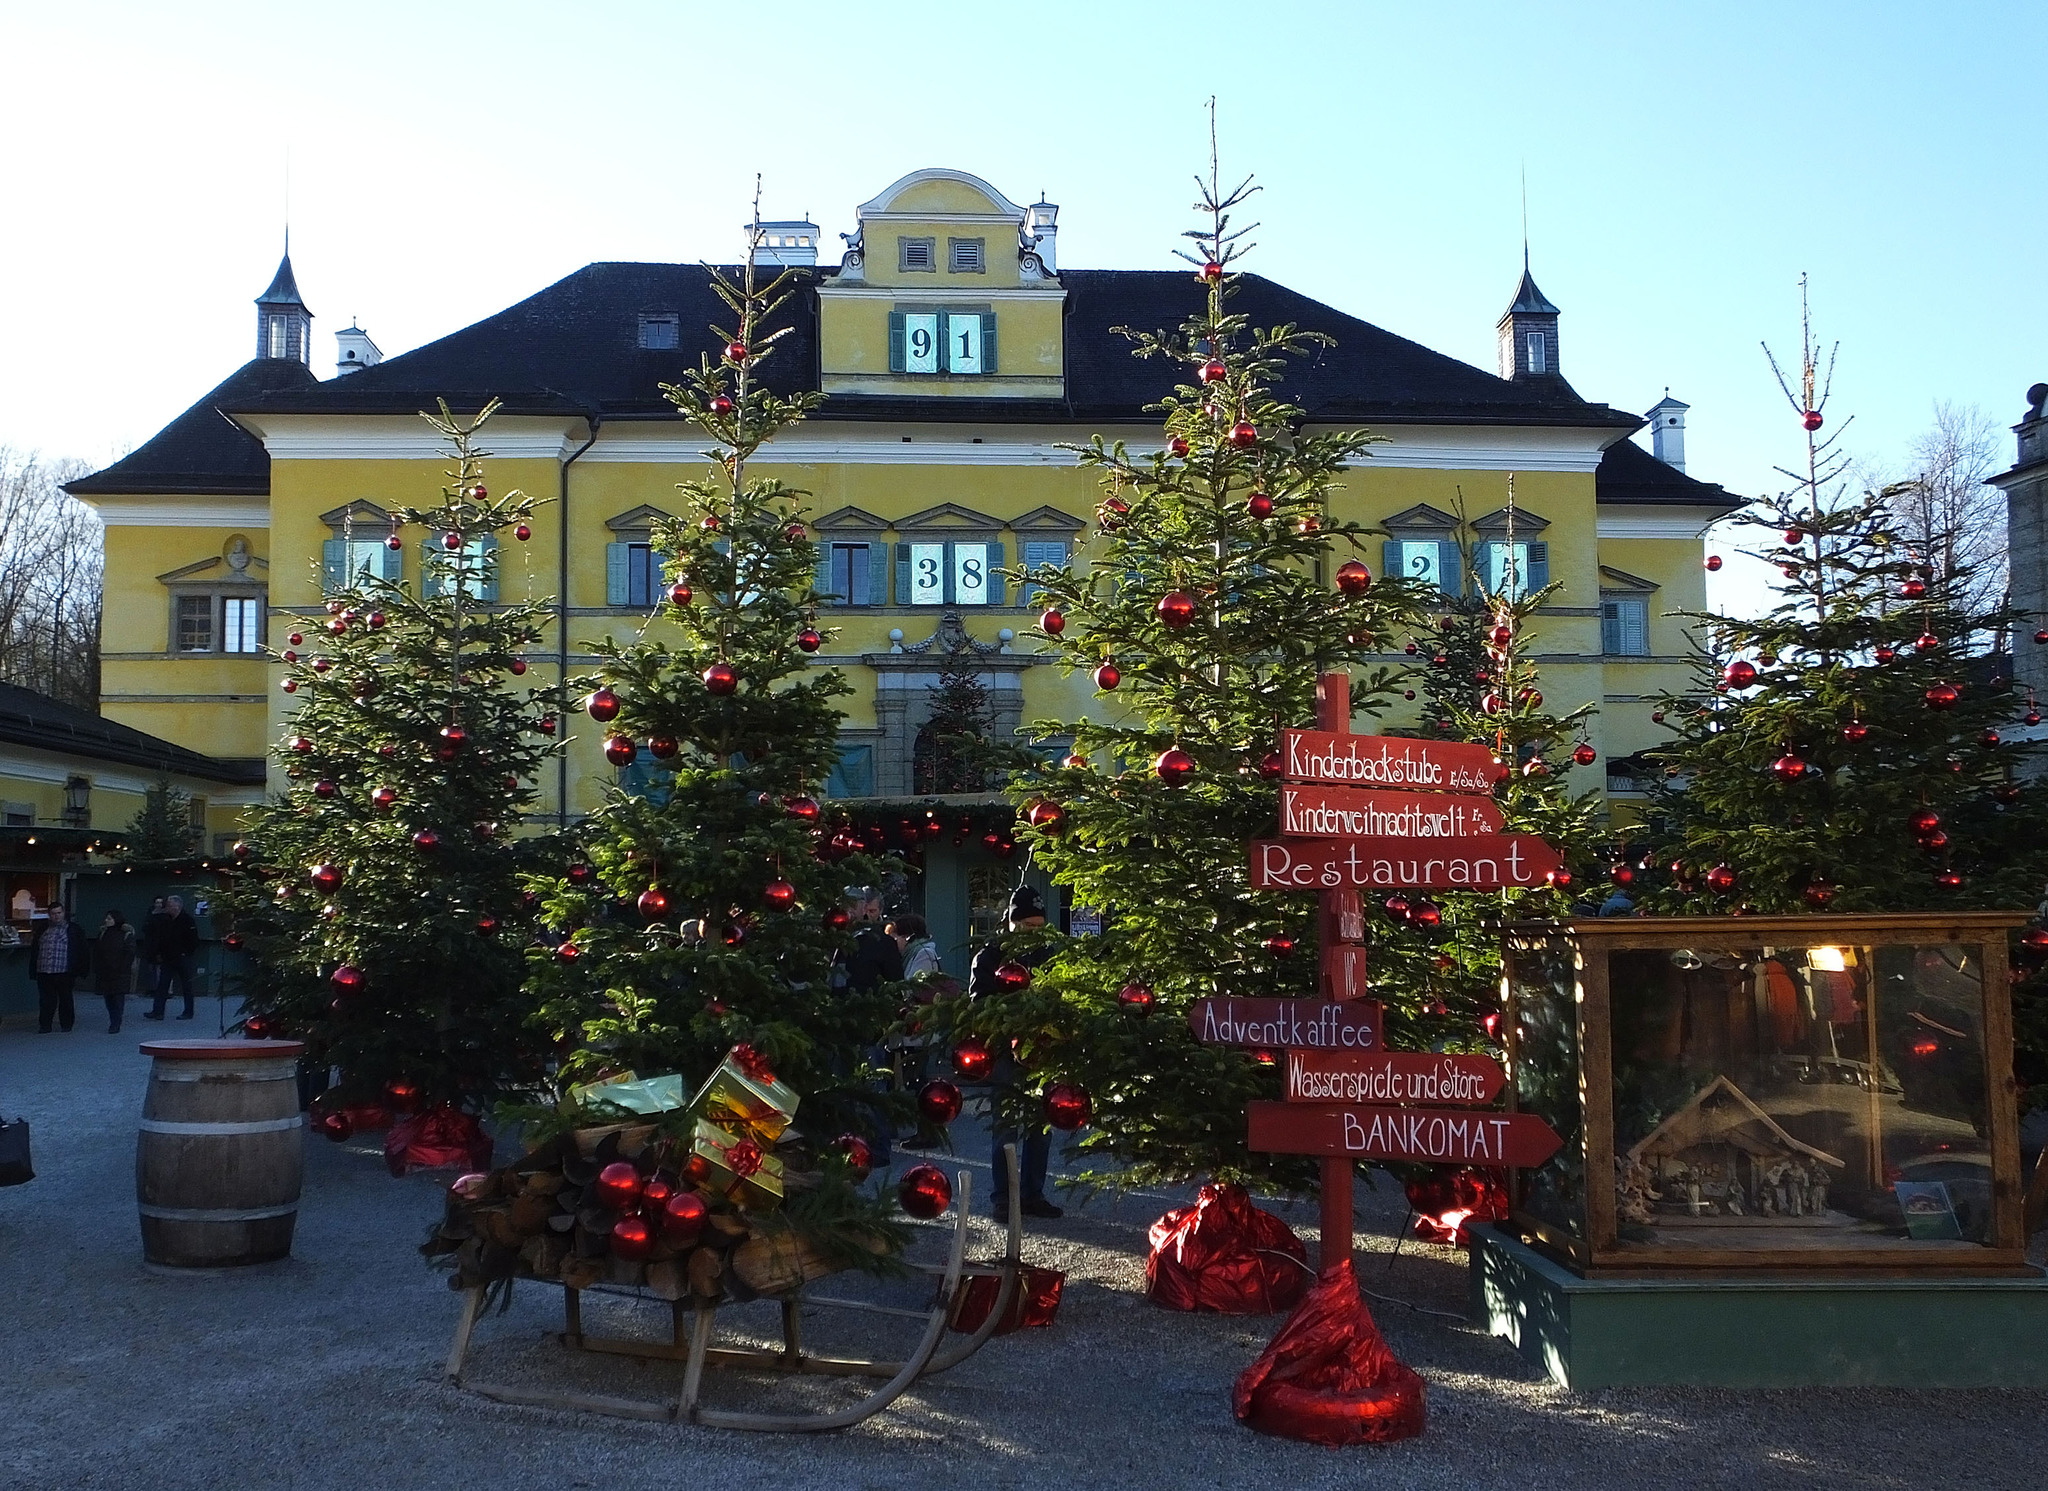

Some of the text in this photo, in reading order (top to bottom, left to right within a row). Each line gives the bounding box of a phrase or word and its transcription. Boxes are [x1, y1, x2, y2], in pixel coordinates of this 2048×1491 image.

[912, 329, 931, 358] 9
[958, 330, 973, 358] 1
[918, 559, 938, 588] 3
[962, 559, 982, 588] 8
[1411, 556, 1431, 583] 2
[1503, 557, 1520, 587] 5
[1288, 734, 1443, 785] Kinderbackstube
[1261, 839, 1532, 888] Restaurant
[1203, 1001, 1373, 1047] Adventkaffee
[1289, 1054, 1402, 1102] Wasserspiele
[1407, 1063, 1438, 1099] und
[1344, 1112, 1511, 1160] BANKOMAT
